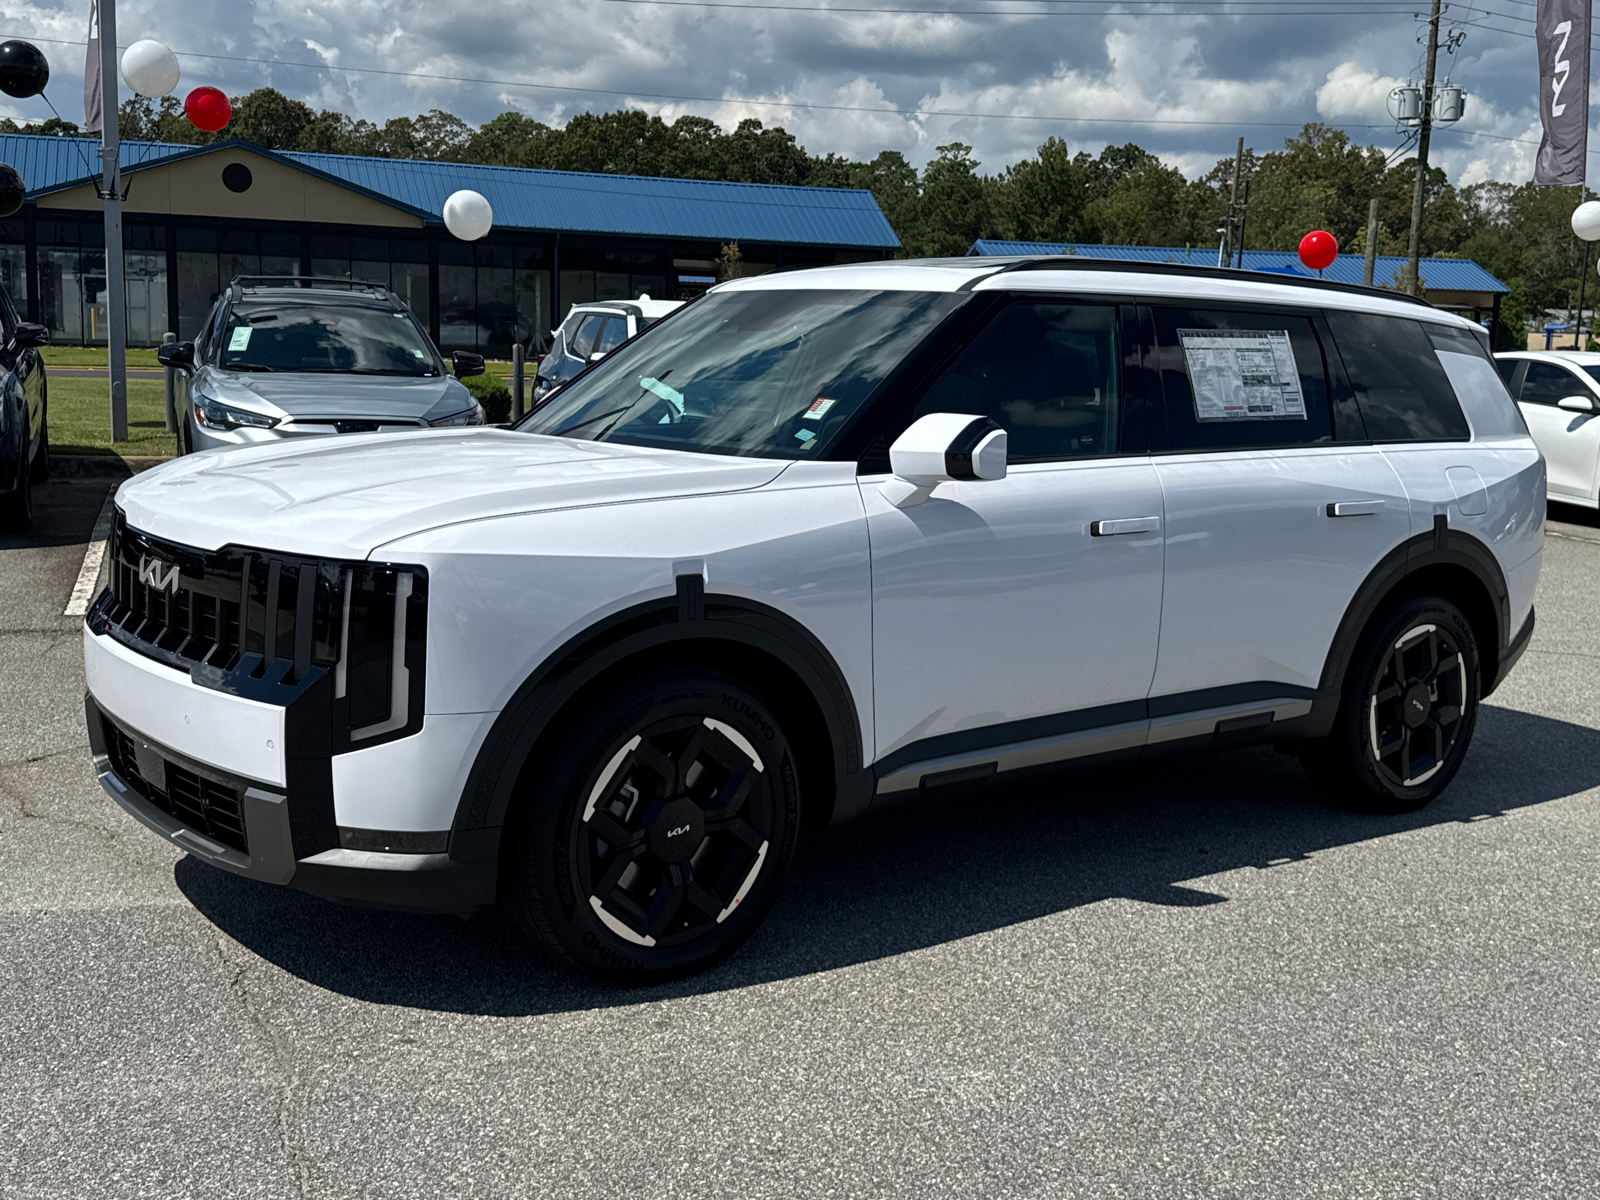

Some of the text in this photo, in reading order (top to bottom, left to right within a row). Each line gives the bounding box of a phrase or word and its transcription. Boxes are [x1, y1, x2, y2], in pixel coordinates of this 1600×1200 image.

[139, 554, 180, 595] KIA
[1451, 612, 1475, 652] KUMHO
[720, 693, 776, 741] KUMHO
[667, 824, 690, 838] KIA
[581, 930, 645, 972] KUMHO
